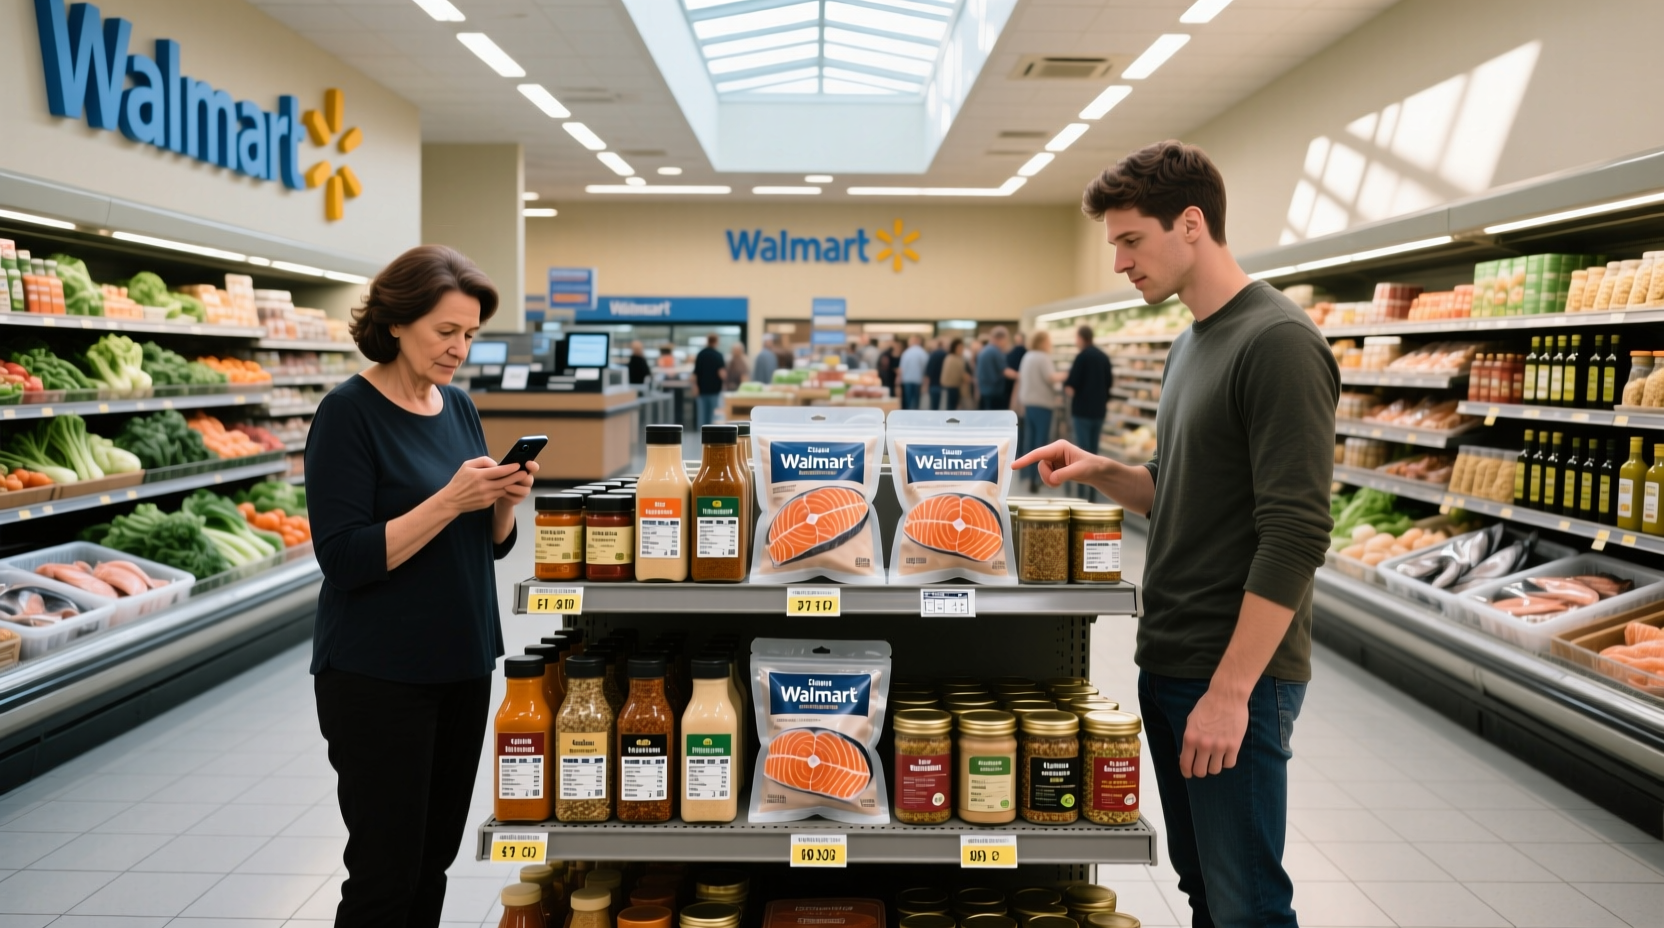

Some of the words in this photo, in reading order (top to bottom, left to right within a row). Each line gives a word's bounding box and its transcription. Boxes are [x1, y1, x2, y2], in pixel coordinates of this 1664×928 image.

[33, 0, 306, 191] Walmart
[726, 228, 870, 263] Walmart
[609, 300, 671, 317] Walmart
[780, 453, 855, 469] Walmart
[915, 454, 989, 470] Walmart
[780, 685, 859, 704] Walmart
